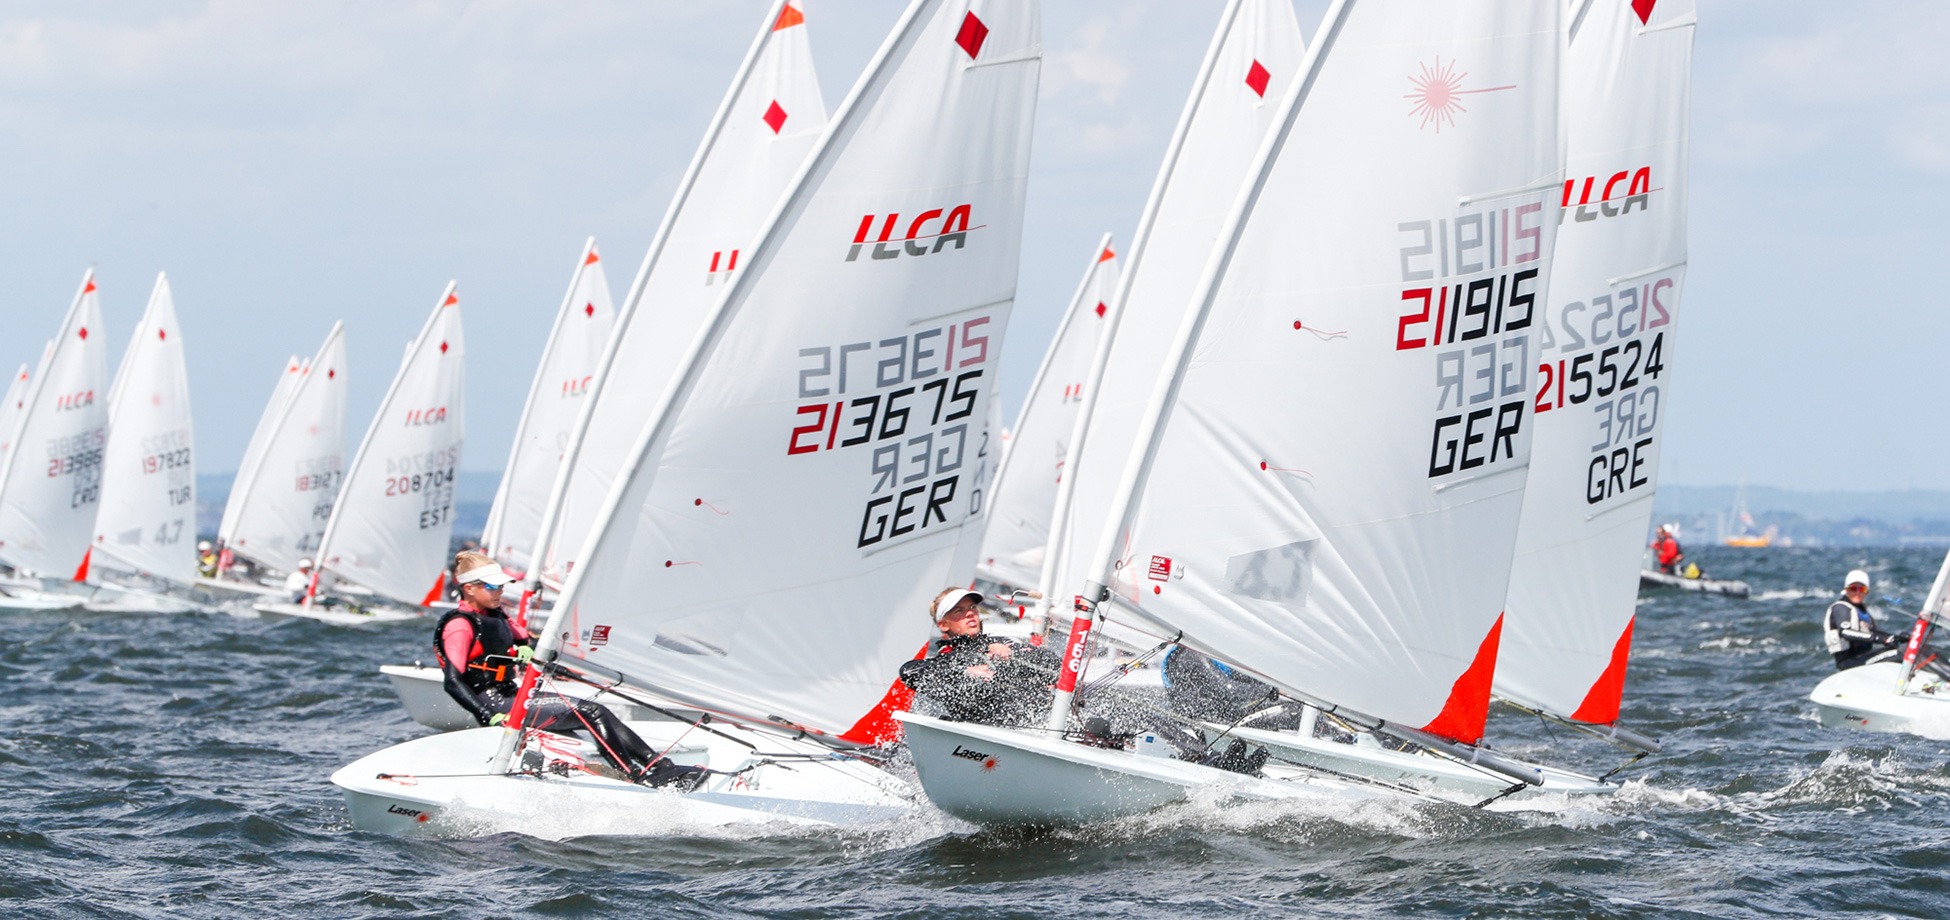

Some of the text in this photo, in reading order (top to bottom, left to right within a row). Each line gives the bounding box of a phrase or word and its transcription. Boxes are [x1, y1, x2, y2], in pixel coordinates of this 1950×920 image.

[1558, 166, 1651, 225] ILCA
[845, 204, 970, 262] ILCA
[1396, 268, 1539, 350] 211915
[562, 376, 592, 398] ILC
[1534, 332, 1664, 414] 215524
[57, 390, 94, 411] ILCA
[787, 369, 983, 455] 213675
[405, 407, 446, 426] ILCA
[1428, 400, 1525, 478] GER
[143, 448, 190, 473] 197822
[1587, 437, 1652, 505] GRE
[168, 485, 191, 506] TUR
[385, 467, 454, 497] 208704
[420, 505, 449, 530] EST
[857, 475, 959, 549] GER
[154, 519, 183, 546] 4.7
[952, 745, 989, 761] Laser
[387, 804, 421, 817] Laser
